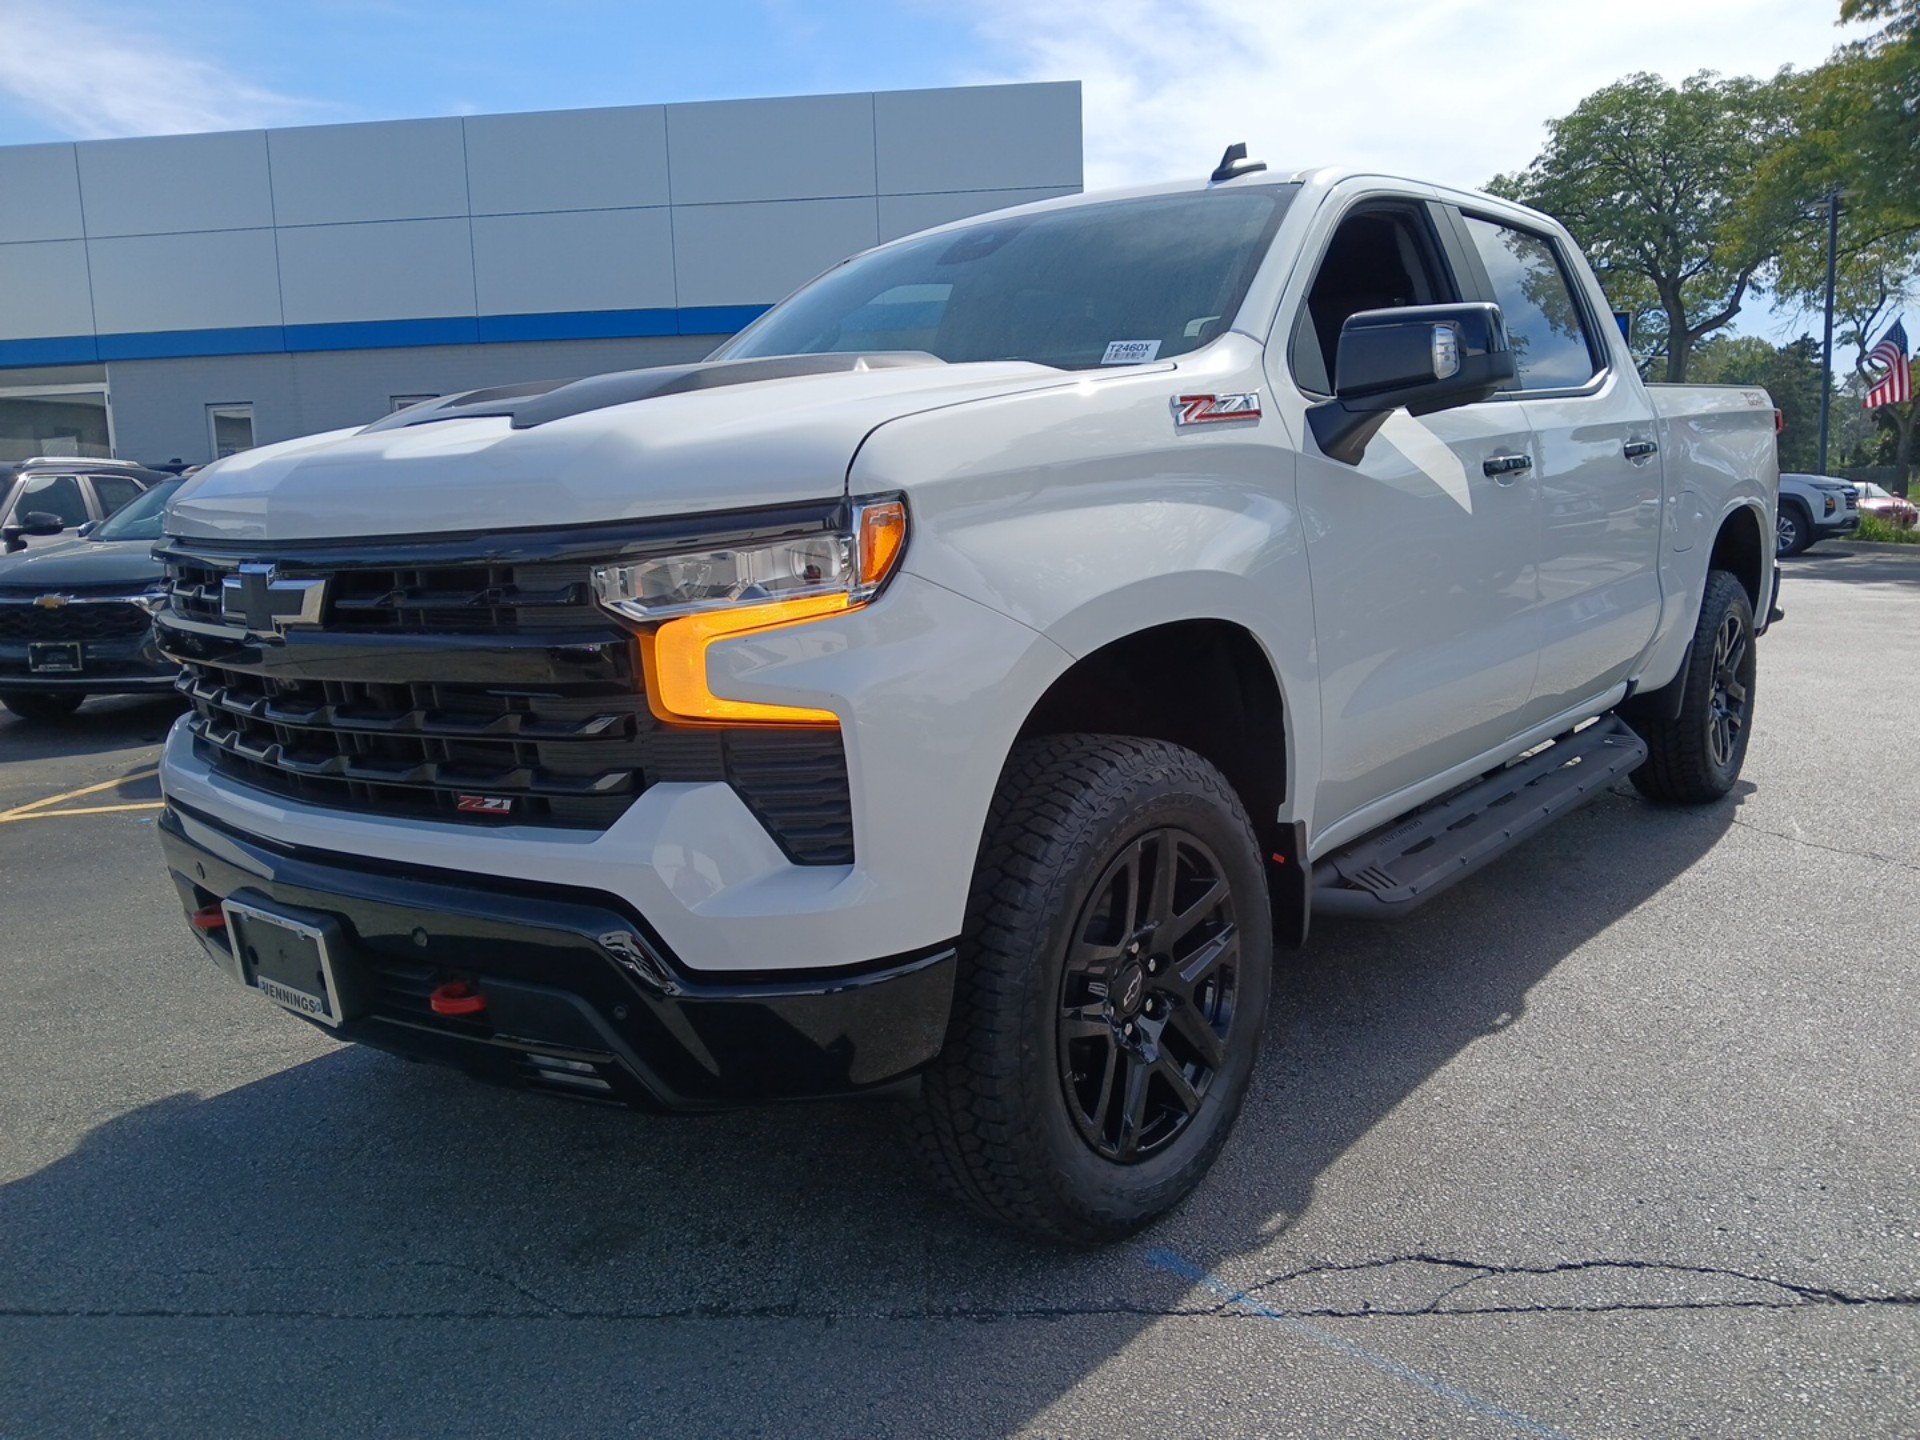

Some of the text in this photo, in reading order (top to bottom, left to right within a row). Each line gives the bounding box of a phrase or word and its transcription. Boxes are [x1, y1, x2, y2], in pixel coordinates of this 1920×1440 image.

[1110, 343, 1151, 353] T2460X
[1171, 392, 1262, 426] Z71
[458, 795, 513, 814] Z71
[263, 982, 316, 1014] JENNINGS
